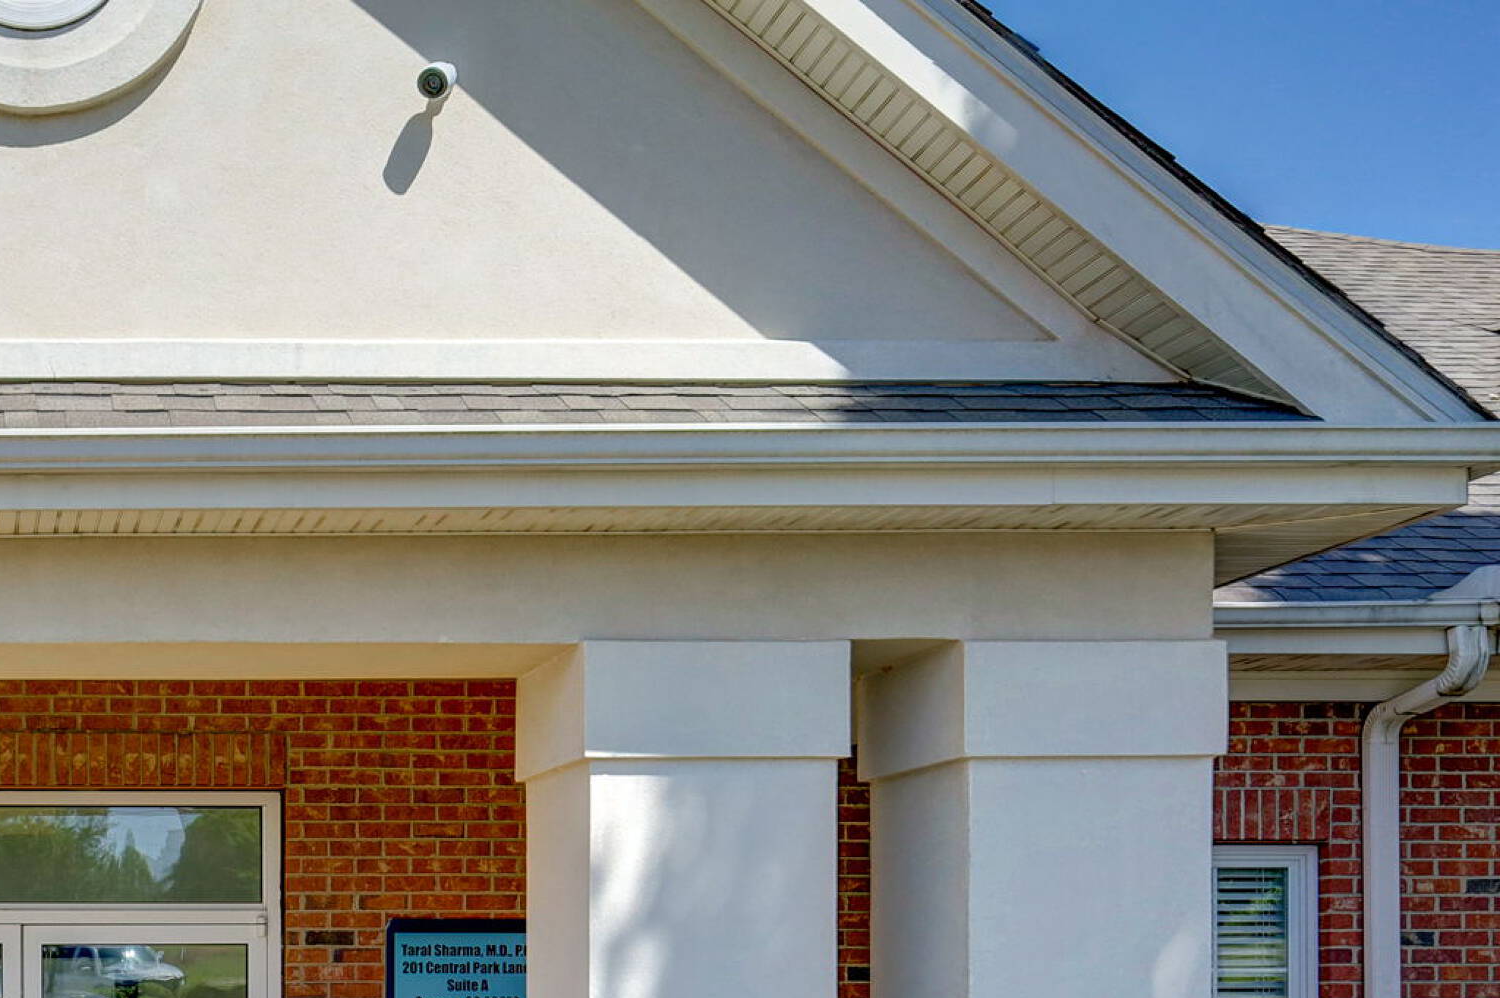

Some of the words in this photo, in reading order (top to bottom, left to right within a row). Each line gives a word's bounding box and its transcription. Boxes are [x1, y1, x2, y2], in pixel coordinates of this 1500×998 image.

[401, 944, 431, 957] Taral
[402, 961, 423, 974] 201
[426, 961, 470, 974] Central
[473, 961, 500, 974] Park
[447, 979, 479, 992] Suite
[481, 979, 489, 991] A
